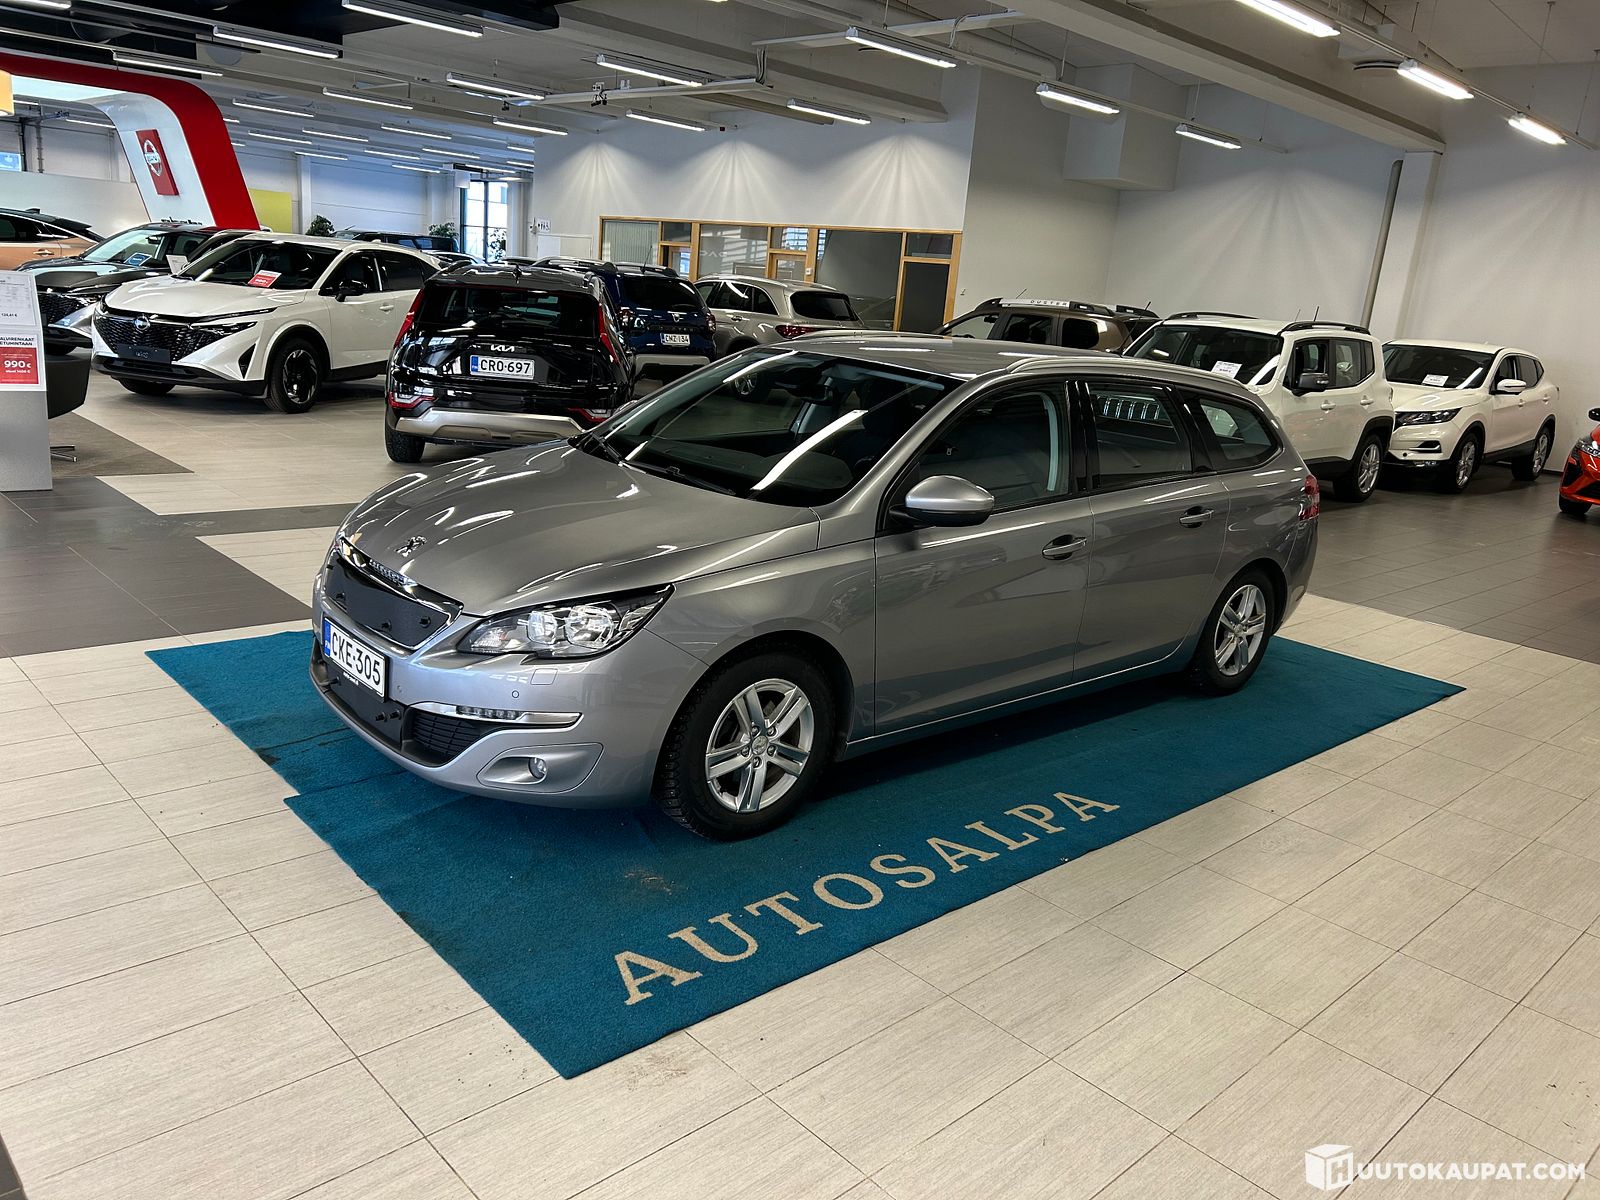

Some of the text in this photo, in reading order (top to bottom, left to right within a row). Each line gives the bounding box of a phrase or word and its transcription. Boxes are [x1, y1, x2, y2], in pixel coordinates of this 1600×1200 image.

[490, 344, 515, 352] KIA
[480, 359, 531, 374] CRO-697
[332, 631, 380, 686] CKE-305
[614, 791, 1120, 1006] AUTOSALPA
